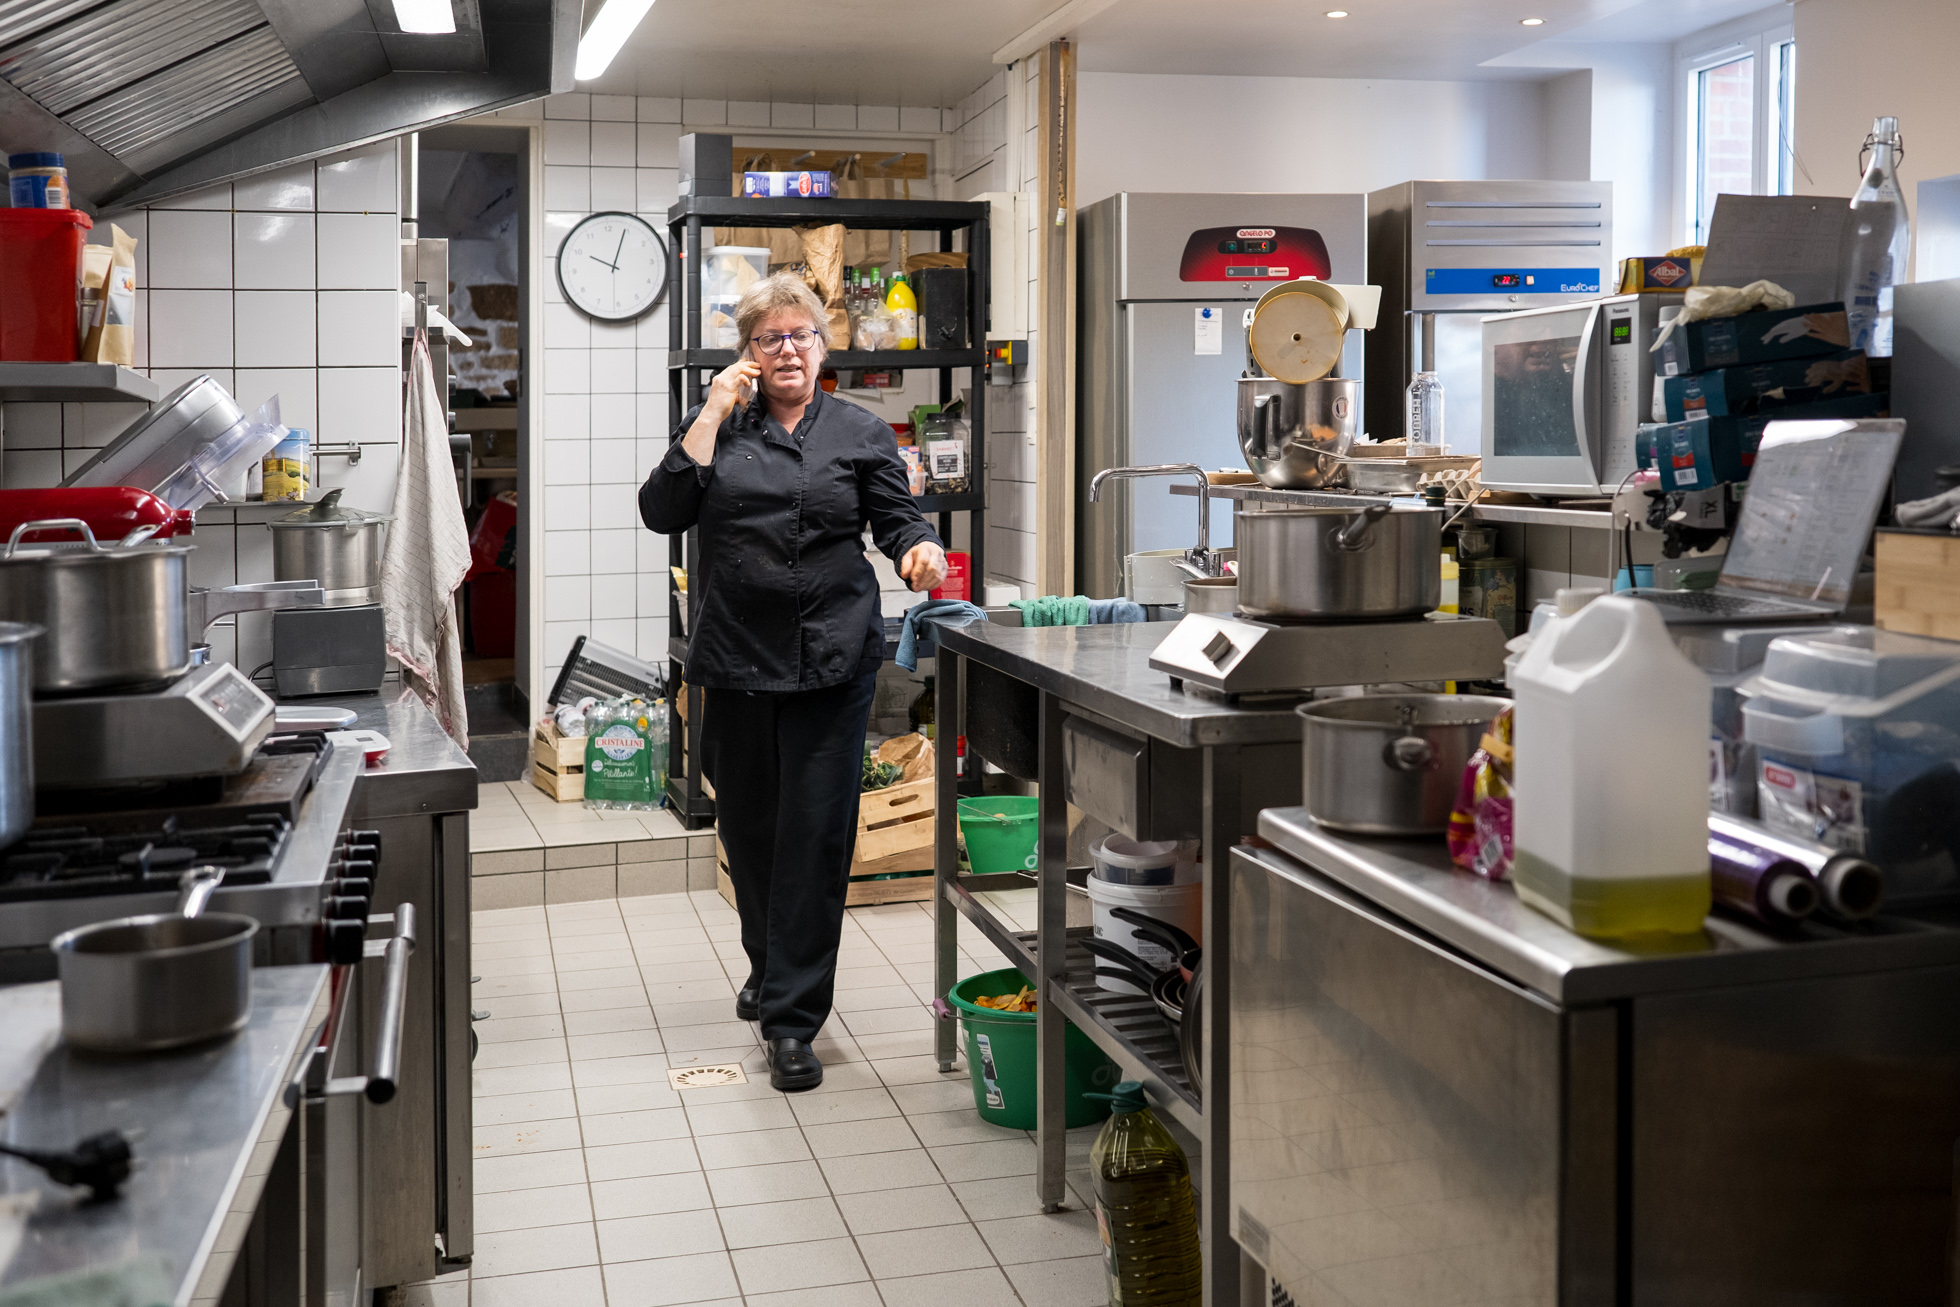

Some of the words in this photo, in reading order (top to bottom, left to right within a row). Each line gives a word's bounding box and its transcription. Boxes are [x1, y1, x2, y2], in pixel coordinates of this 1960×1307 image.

[1654, 266, 1680, 276] Albal
[1501, 276, 1511, 284] 22
[1704, 500, 1718, 519] XL
[595, 738, 644, 748] CRISTALINE
